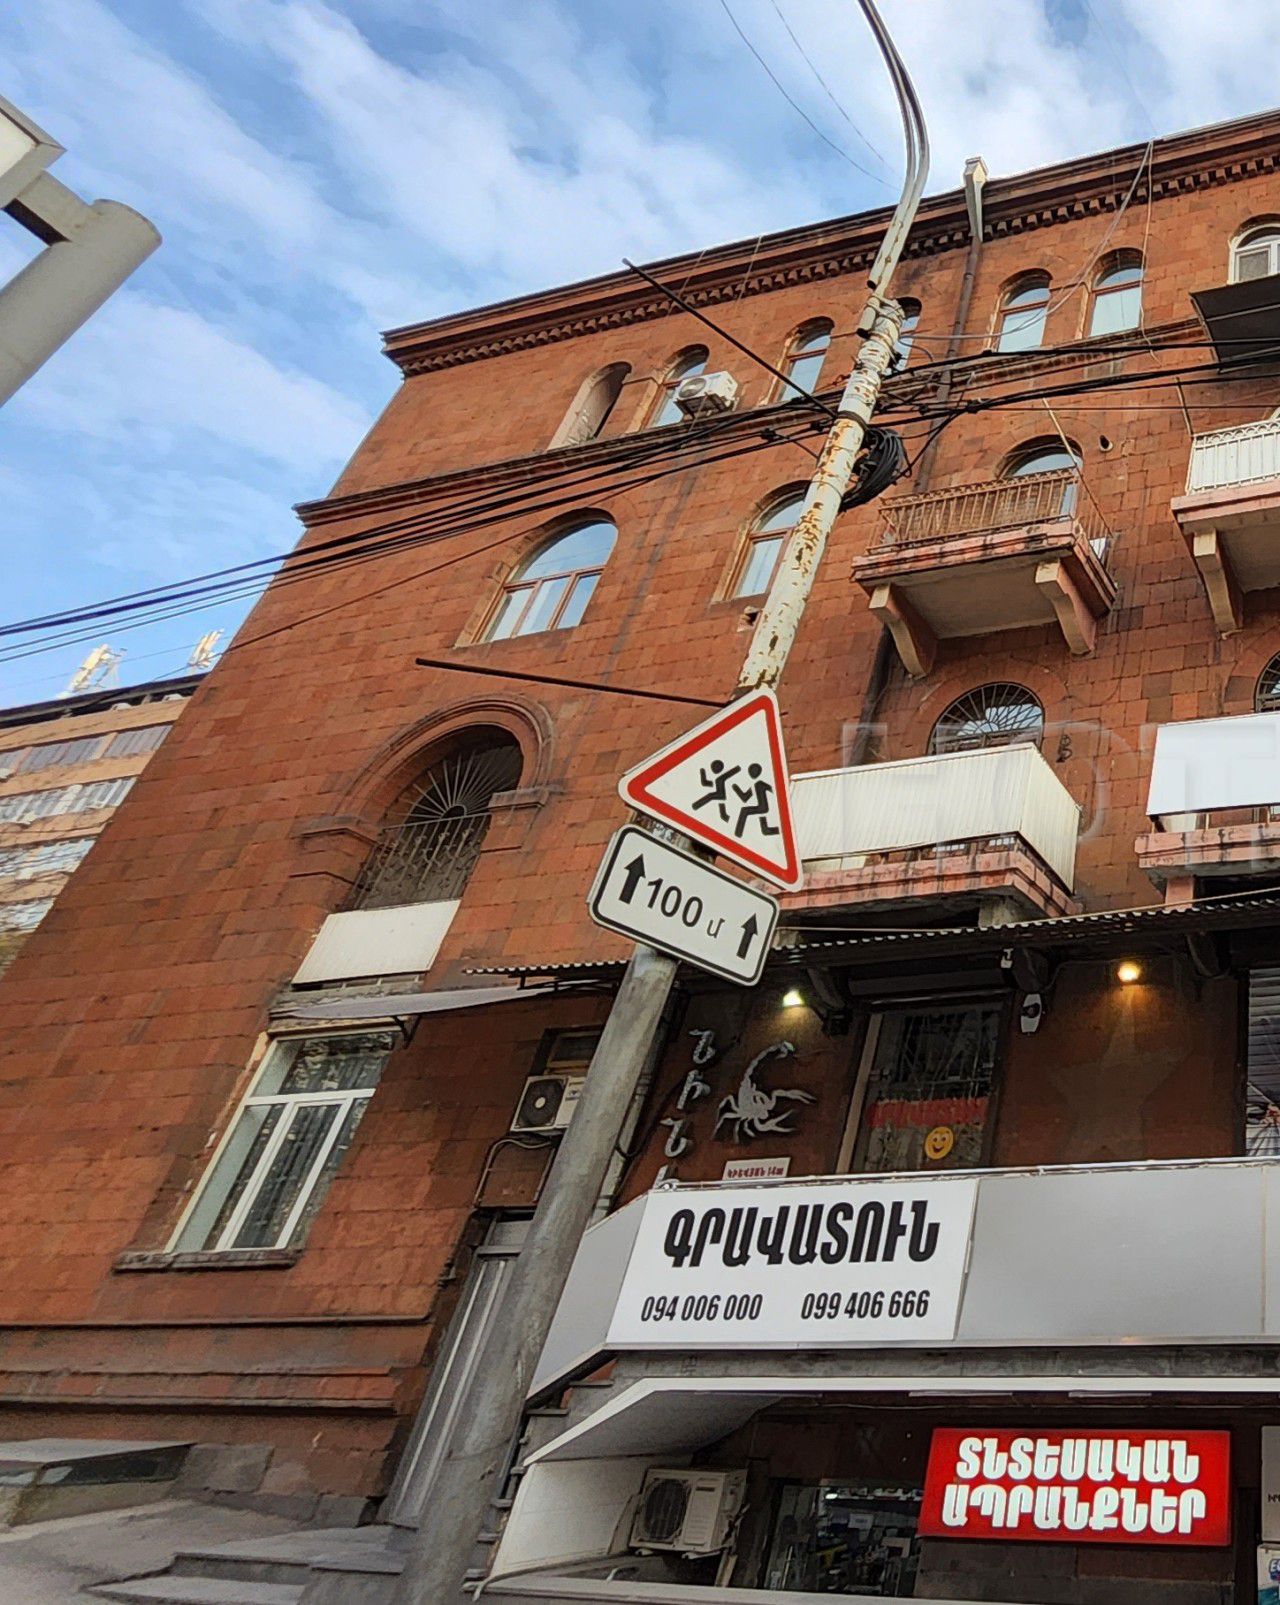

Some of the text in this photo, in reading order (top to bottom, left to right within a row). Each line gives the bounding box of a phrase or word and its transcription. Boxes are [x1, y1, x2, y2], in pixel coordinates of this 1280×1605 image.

[646, 876, 704, 929] 100
[663, 1199, 942, 1269] ԳՐԱՎԱՏՈՒՆ
[640, 1290, 930, 1322] 094 006 000 099 406 666
[956, 1437, 1199, 1484] ՏՆՏԵՍԱԿԱՆ
[941, 1483, 1206, 1535] ԱՊՐԱՆՔՆԵՐ
